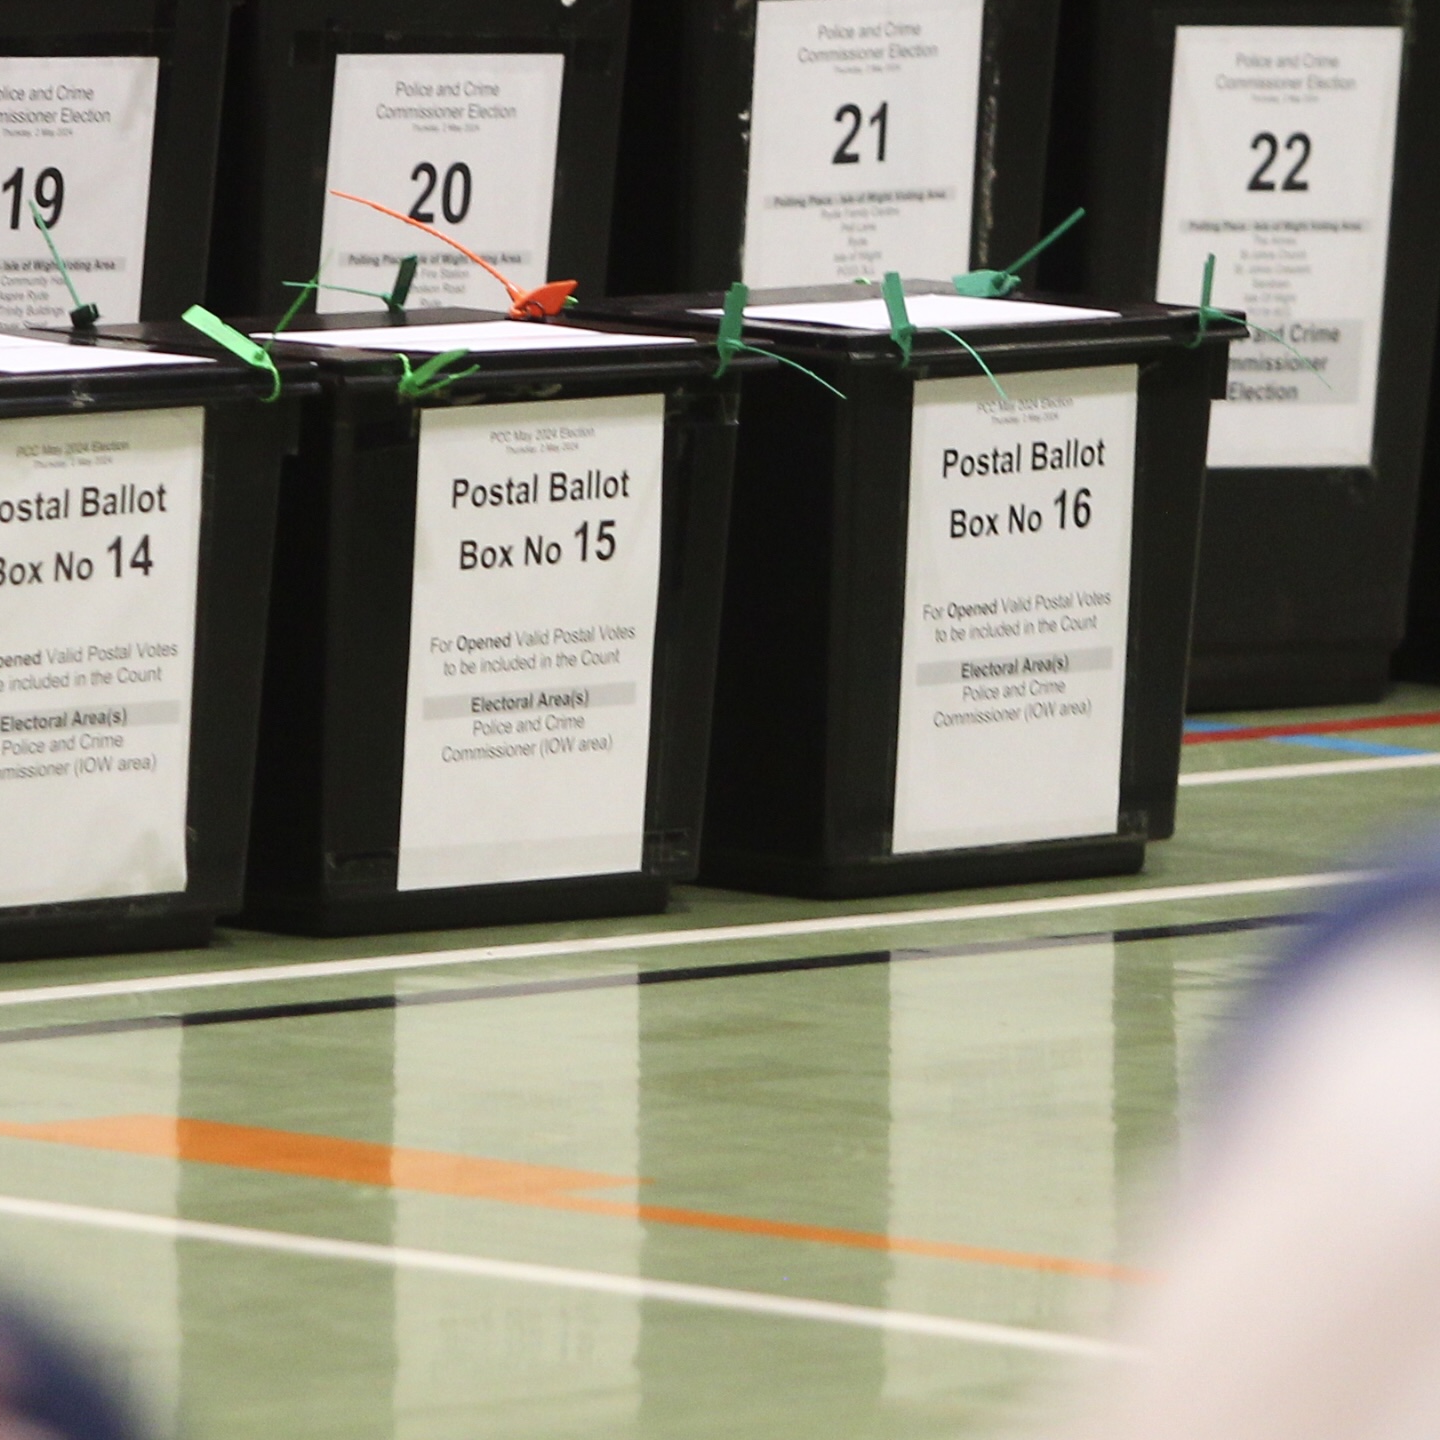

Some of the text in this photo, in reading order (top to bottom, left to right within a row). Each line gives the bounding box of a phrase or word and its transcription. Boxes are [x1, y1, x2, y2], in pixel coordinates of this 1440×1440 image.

[29, 86, 52, 100] and
[56, 85, 94, 100] Crime
[395, 81, 500, 97] Police and Crime
[61, 109, 111, 123] Election
[377, 104, 517, 120] Commissioner Election
[831, 100, 888, 165] 21
[1247, 131, 1313, 191] 22
[2, 166, 64, 230] 19
[409, 162, 472, 224] 20
[942, 439, 1105, 478] Postal Ballot
[81, 484, 167, 517] Ballot
[452, 469, 630, 508] Postal Ballot
[950, 488, 1092, 538] Box No 16
[460, 519, 616, 569] Box No 15
[55, 551, 94, 582] No
[108, 534, 153, 578] 14
[923, 591, 1112, 620] For Opened Valid Postal Votes
[430, 625, 636, 654] For Opened Valid Postal Votes
[935, 614, 1097, 642] to be included in the Count
[46, 648, 83, 665] Valid
[87, 645, 132, 661] Postal
[136, 642, 178, 657] Votes
[444, 648, 619, 676] to be included in the Count
[961, 655, 1069, 678] Electoral Area(s)
[10, 673, 69, 691] included
[74, 673, 86, 686] in
[91, 670, 112, 685] the
[117, 666, 162, 683] Count
[963, 680, 1066, 701] Police and Crime
[471, 689, 589, 713] Electoral Area(s)
[0, 708, 128, 732] Electoral Area(s)
[473, 714, 585, 737] Police and Crime
[933, 707, 1021, 728] Commissioner
[2, 733, 124, 756] Police and Crime
[441, 742, 536, 763] Commissioner
